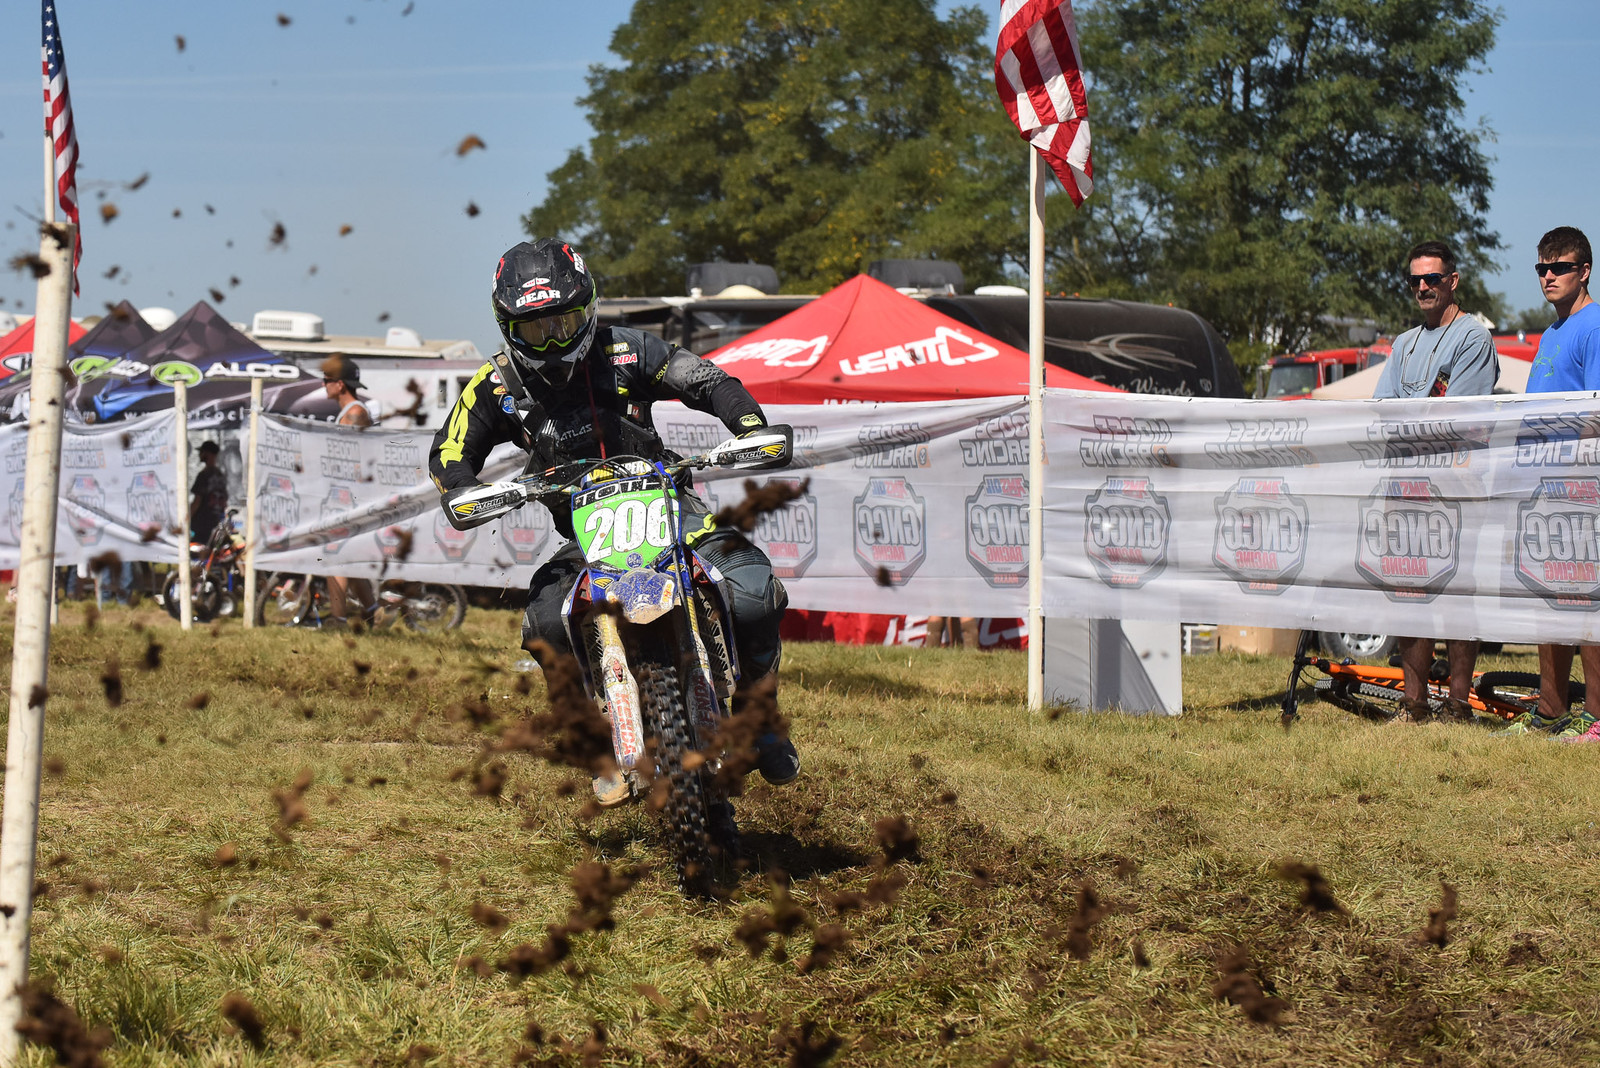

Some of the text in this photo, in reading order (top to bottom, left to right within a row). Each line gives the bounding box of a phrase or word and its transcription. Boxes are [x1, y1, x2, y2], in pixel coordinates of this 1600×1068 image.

[516, 289, 561, 308] GEAR
[840, 323, 999, 376] LEATT
[610, 353, 638, 366] ENDA
[204, 362, 300, 379] ALCO
[1130, 375, 1195, 397] Winds
[560, 423, 593, 442] ATLAS
[736, 450, 767, 460] CYCRA
[584, 498, 680, 564] 206
